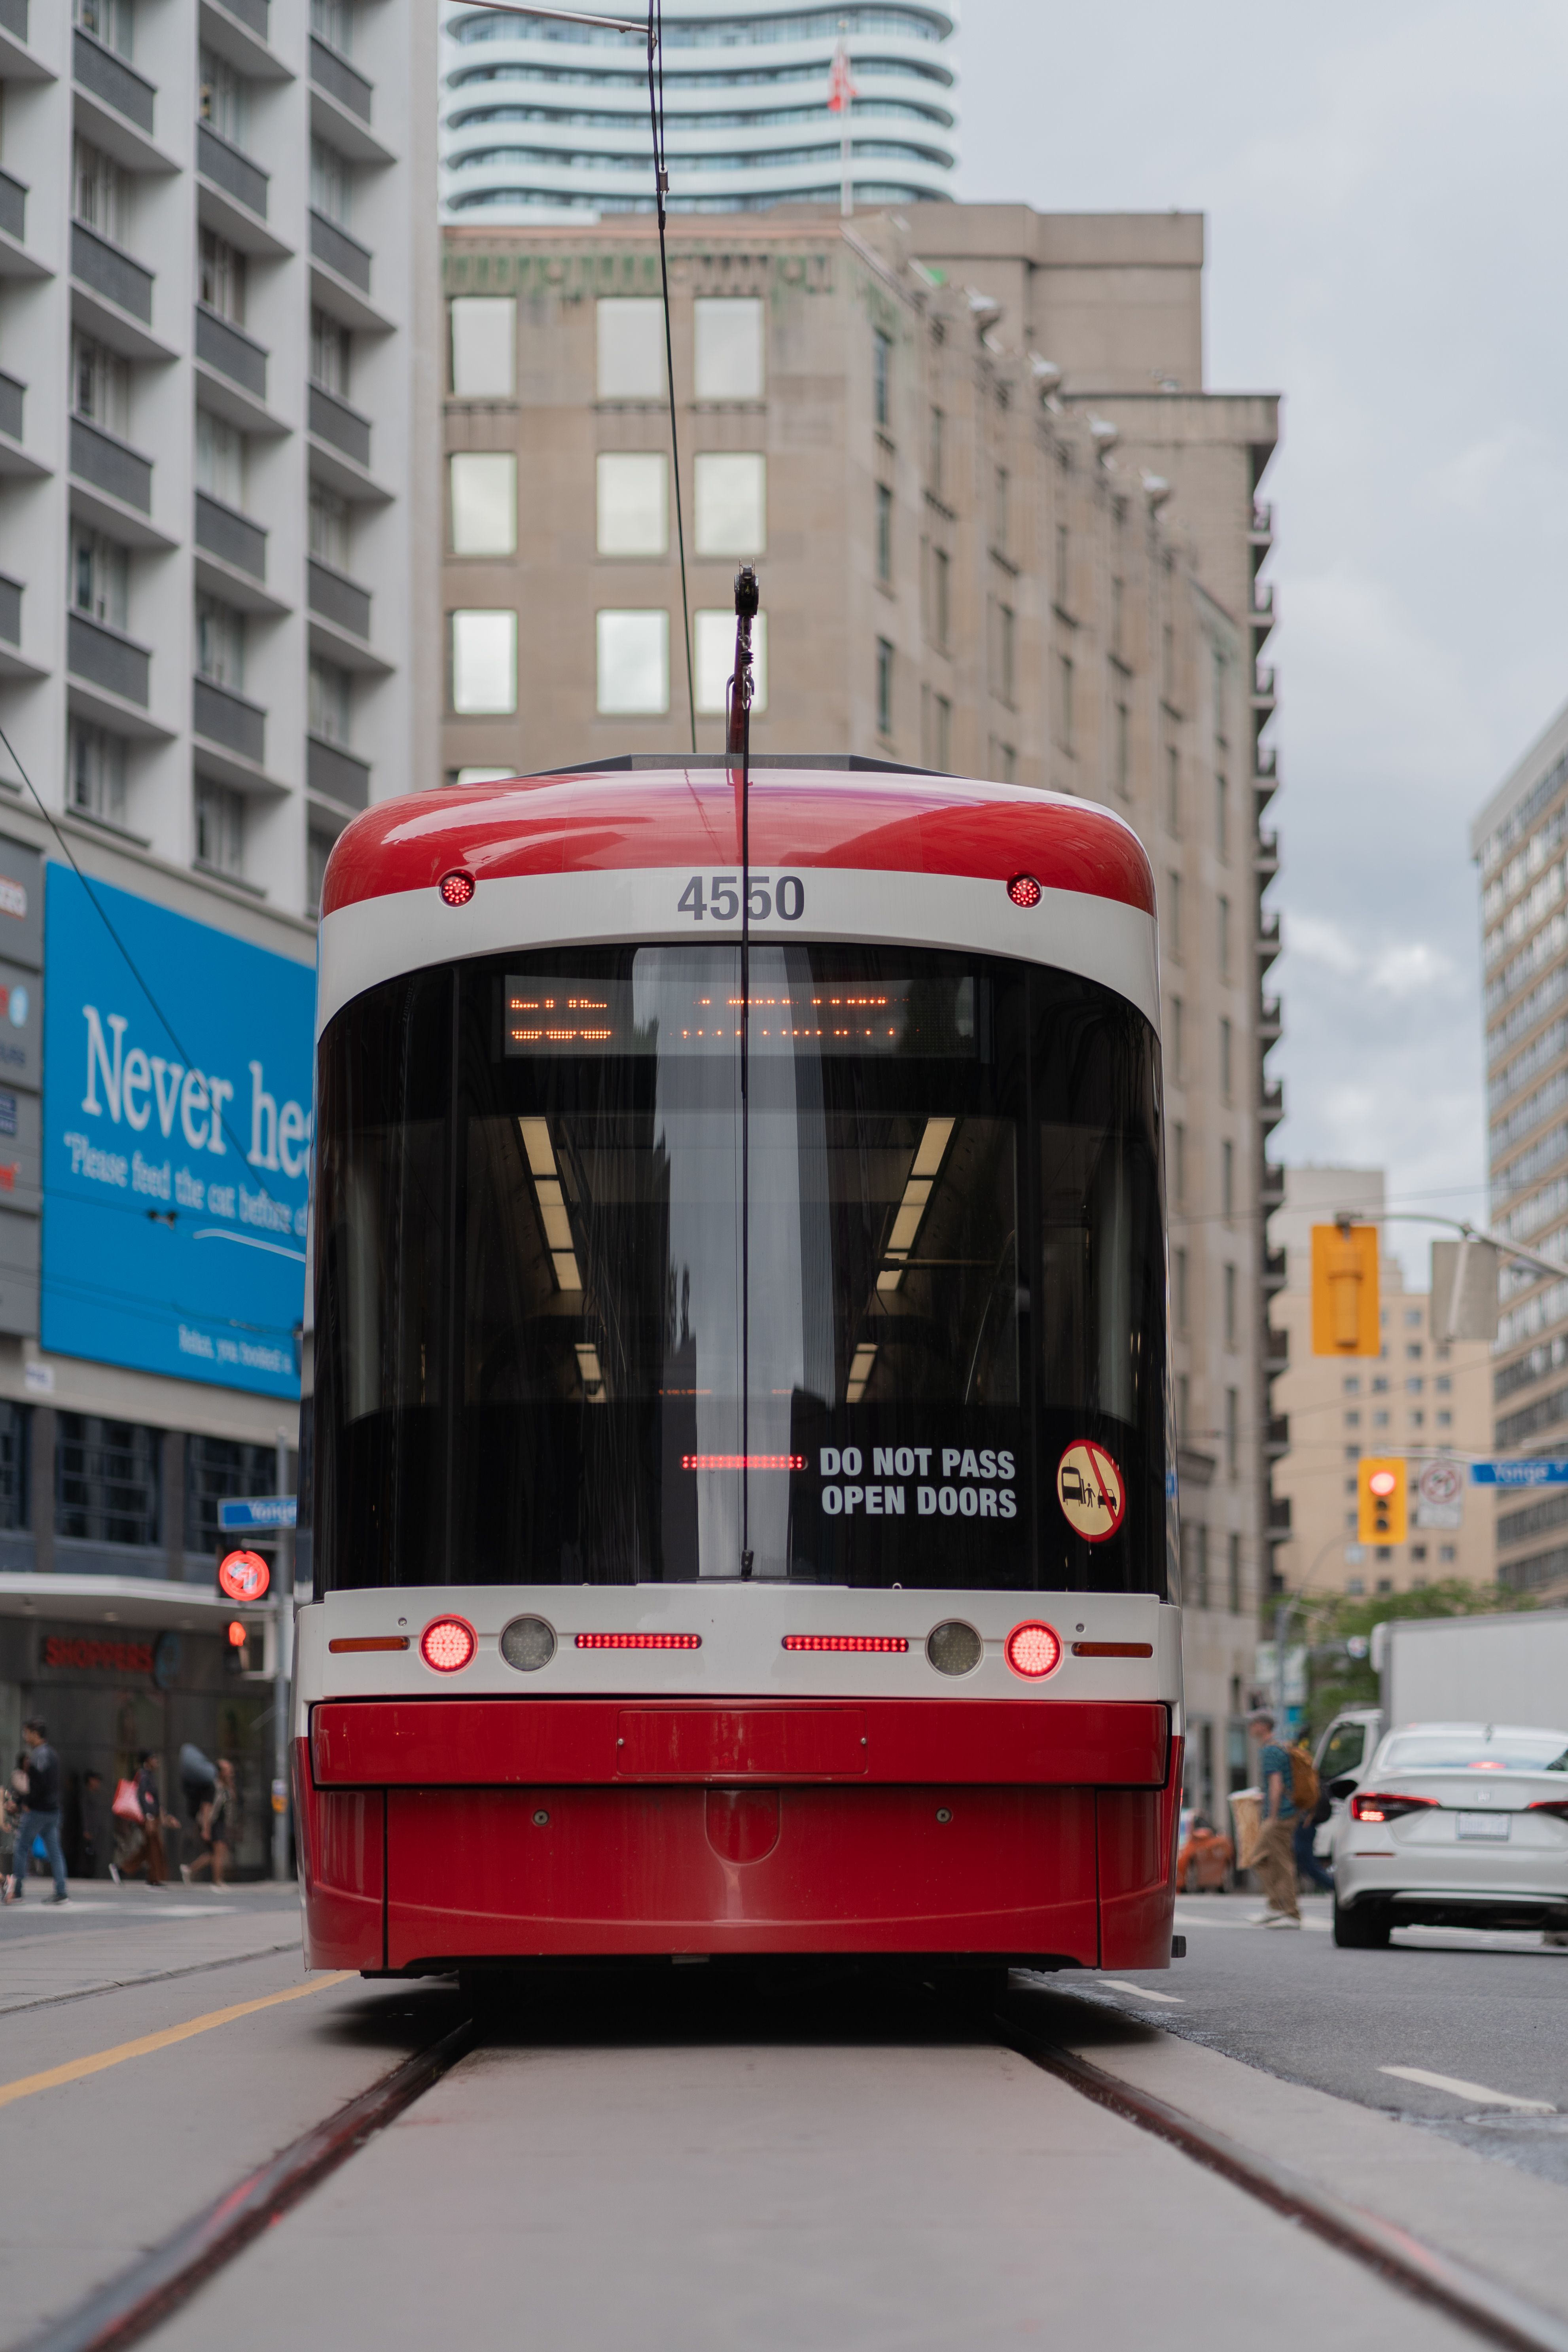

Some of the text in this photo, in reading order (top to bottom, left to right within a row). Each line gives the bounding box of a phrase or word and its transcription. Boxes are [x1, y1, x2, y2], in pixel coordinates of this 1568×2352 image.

[677, 875, 804, 921] 4550
[82, 1004, 234, 1156] Never
[175, 1166, 205, 1210] the
[820, 1447, 1015, 1479] DO NOT PASS
[1492, 1463, 1549, 1487] Yonge
[822, 1486, 1017, 1518] OPEN DOORS
